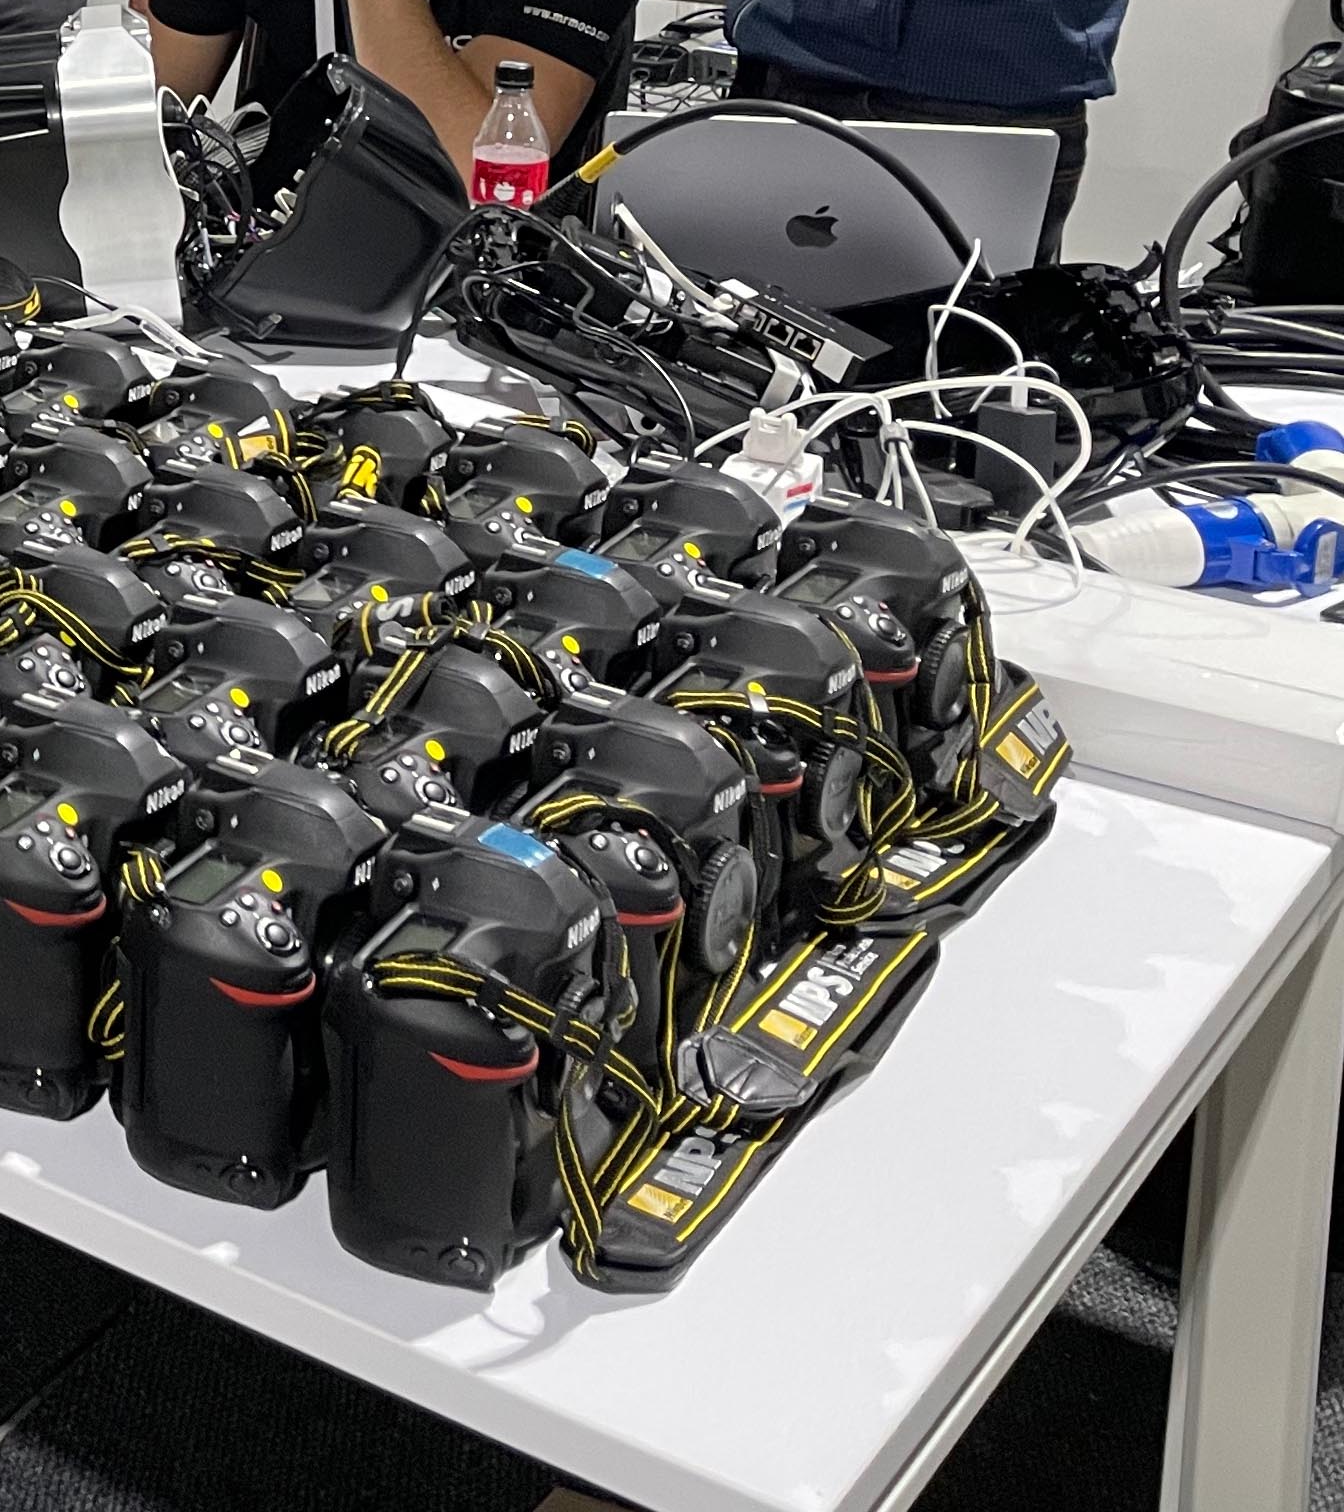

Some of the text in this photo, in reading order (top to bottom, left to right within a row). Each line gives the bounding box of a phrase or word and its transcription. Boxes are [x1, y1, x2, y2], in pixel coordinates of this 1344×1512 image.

[271, 526, 303, 551] Nikon
[132, 614, 166, 642] Nikon
[306, 664, 341, 695] Nikon
[1017, 698, 1060, 755] NP
[146, 780, 184, 814] Nikon
